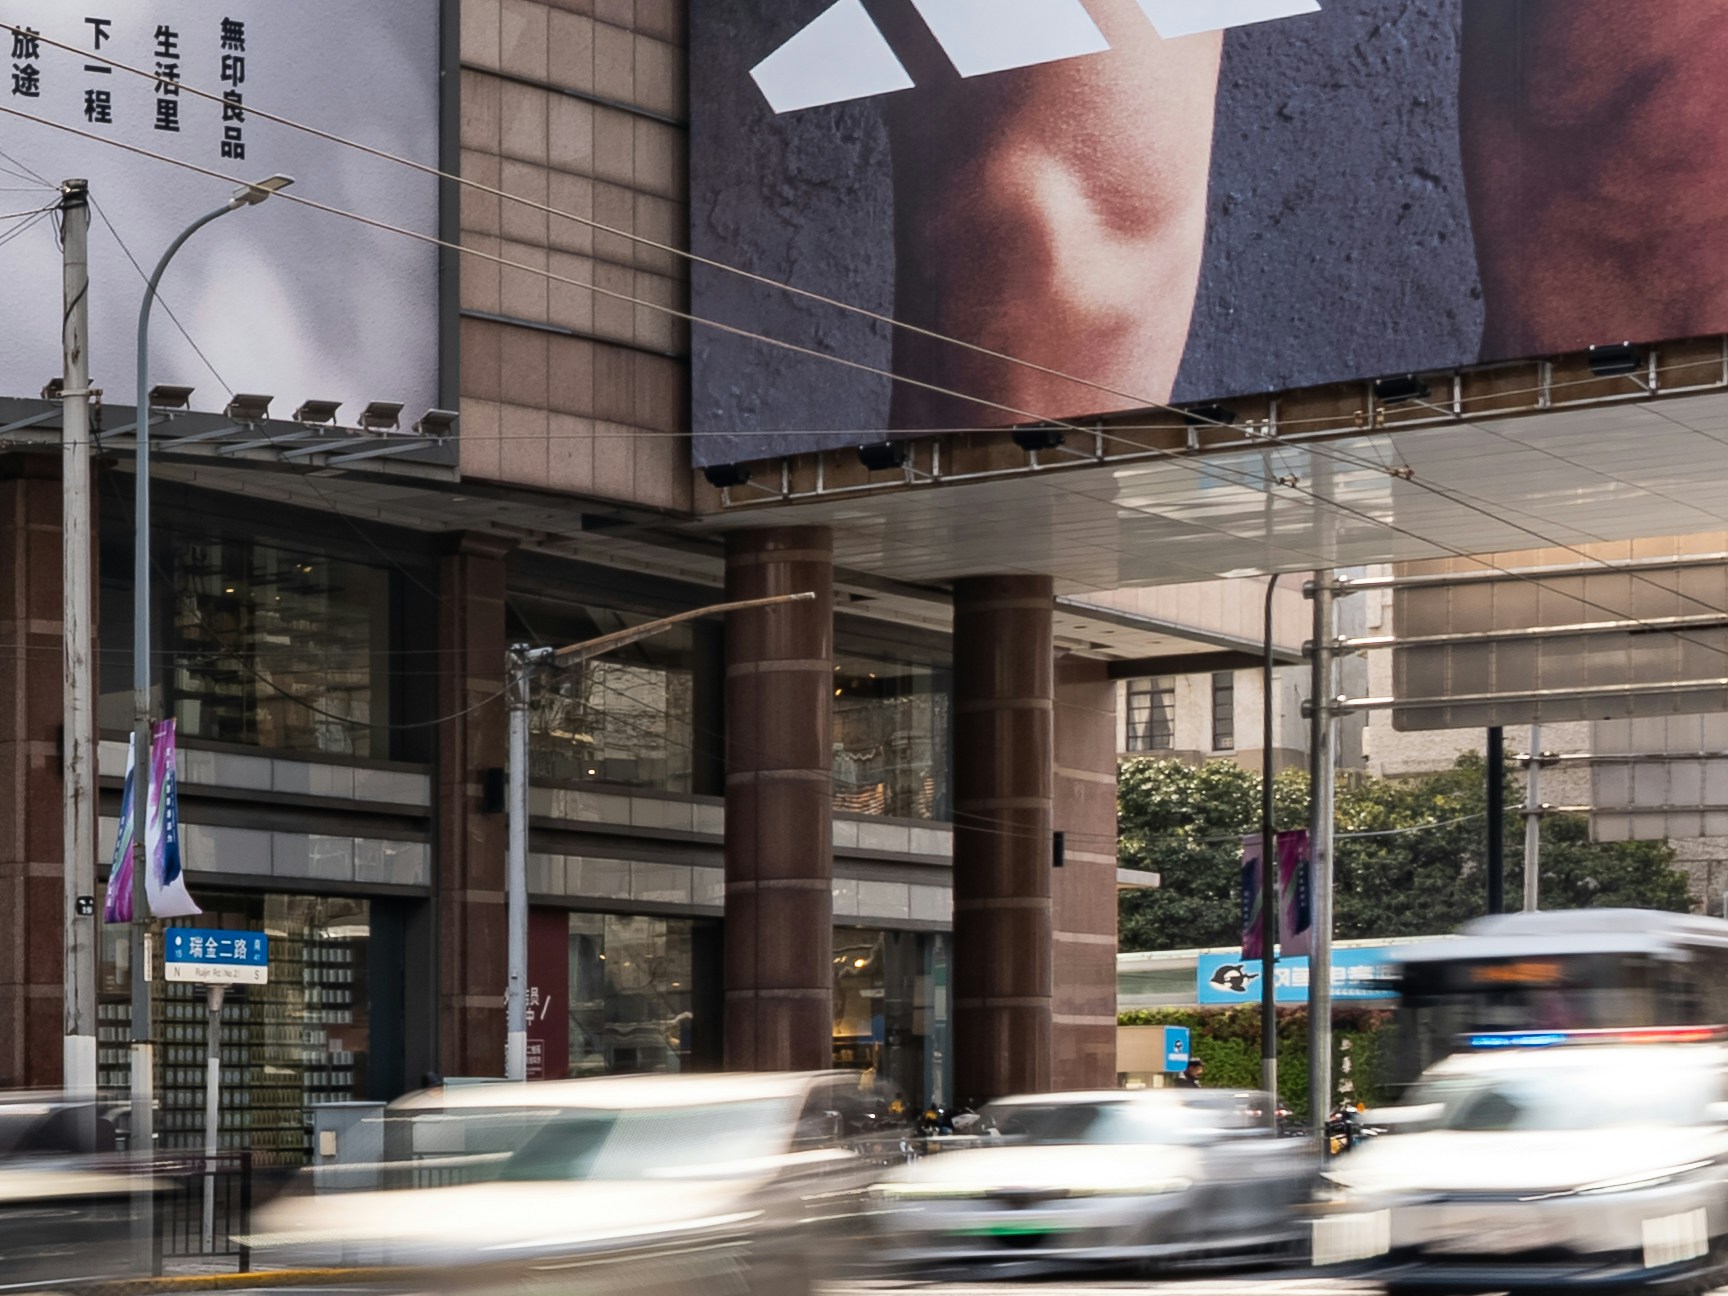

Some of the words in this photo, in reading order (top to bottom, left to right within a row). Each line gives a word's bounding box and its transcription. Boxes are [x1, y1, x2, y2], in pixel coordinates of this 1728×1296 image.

[11, 26, 40, 98] 旅途
[84, 17, 112, 124] 下一程
[154, 24, 180, 132] 生活里
[220, 17, 245, 160] 無印良品
[174, 967, 180, 977] N
[189, 936, 247, 960] 瑞金二路
[254, 970, 260, 980] S
